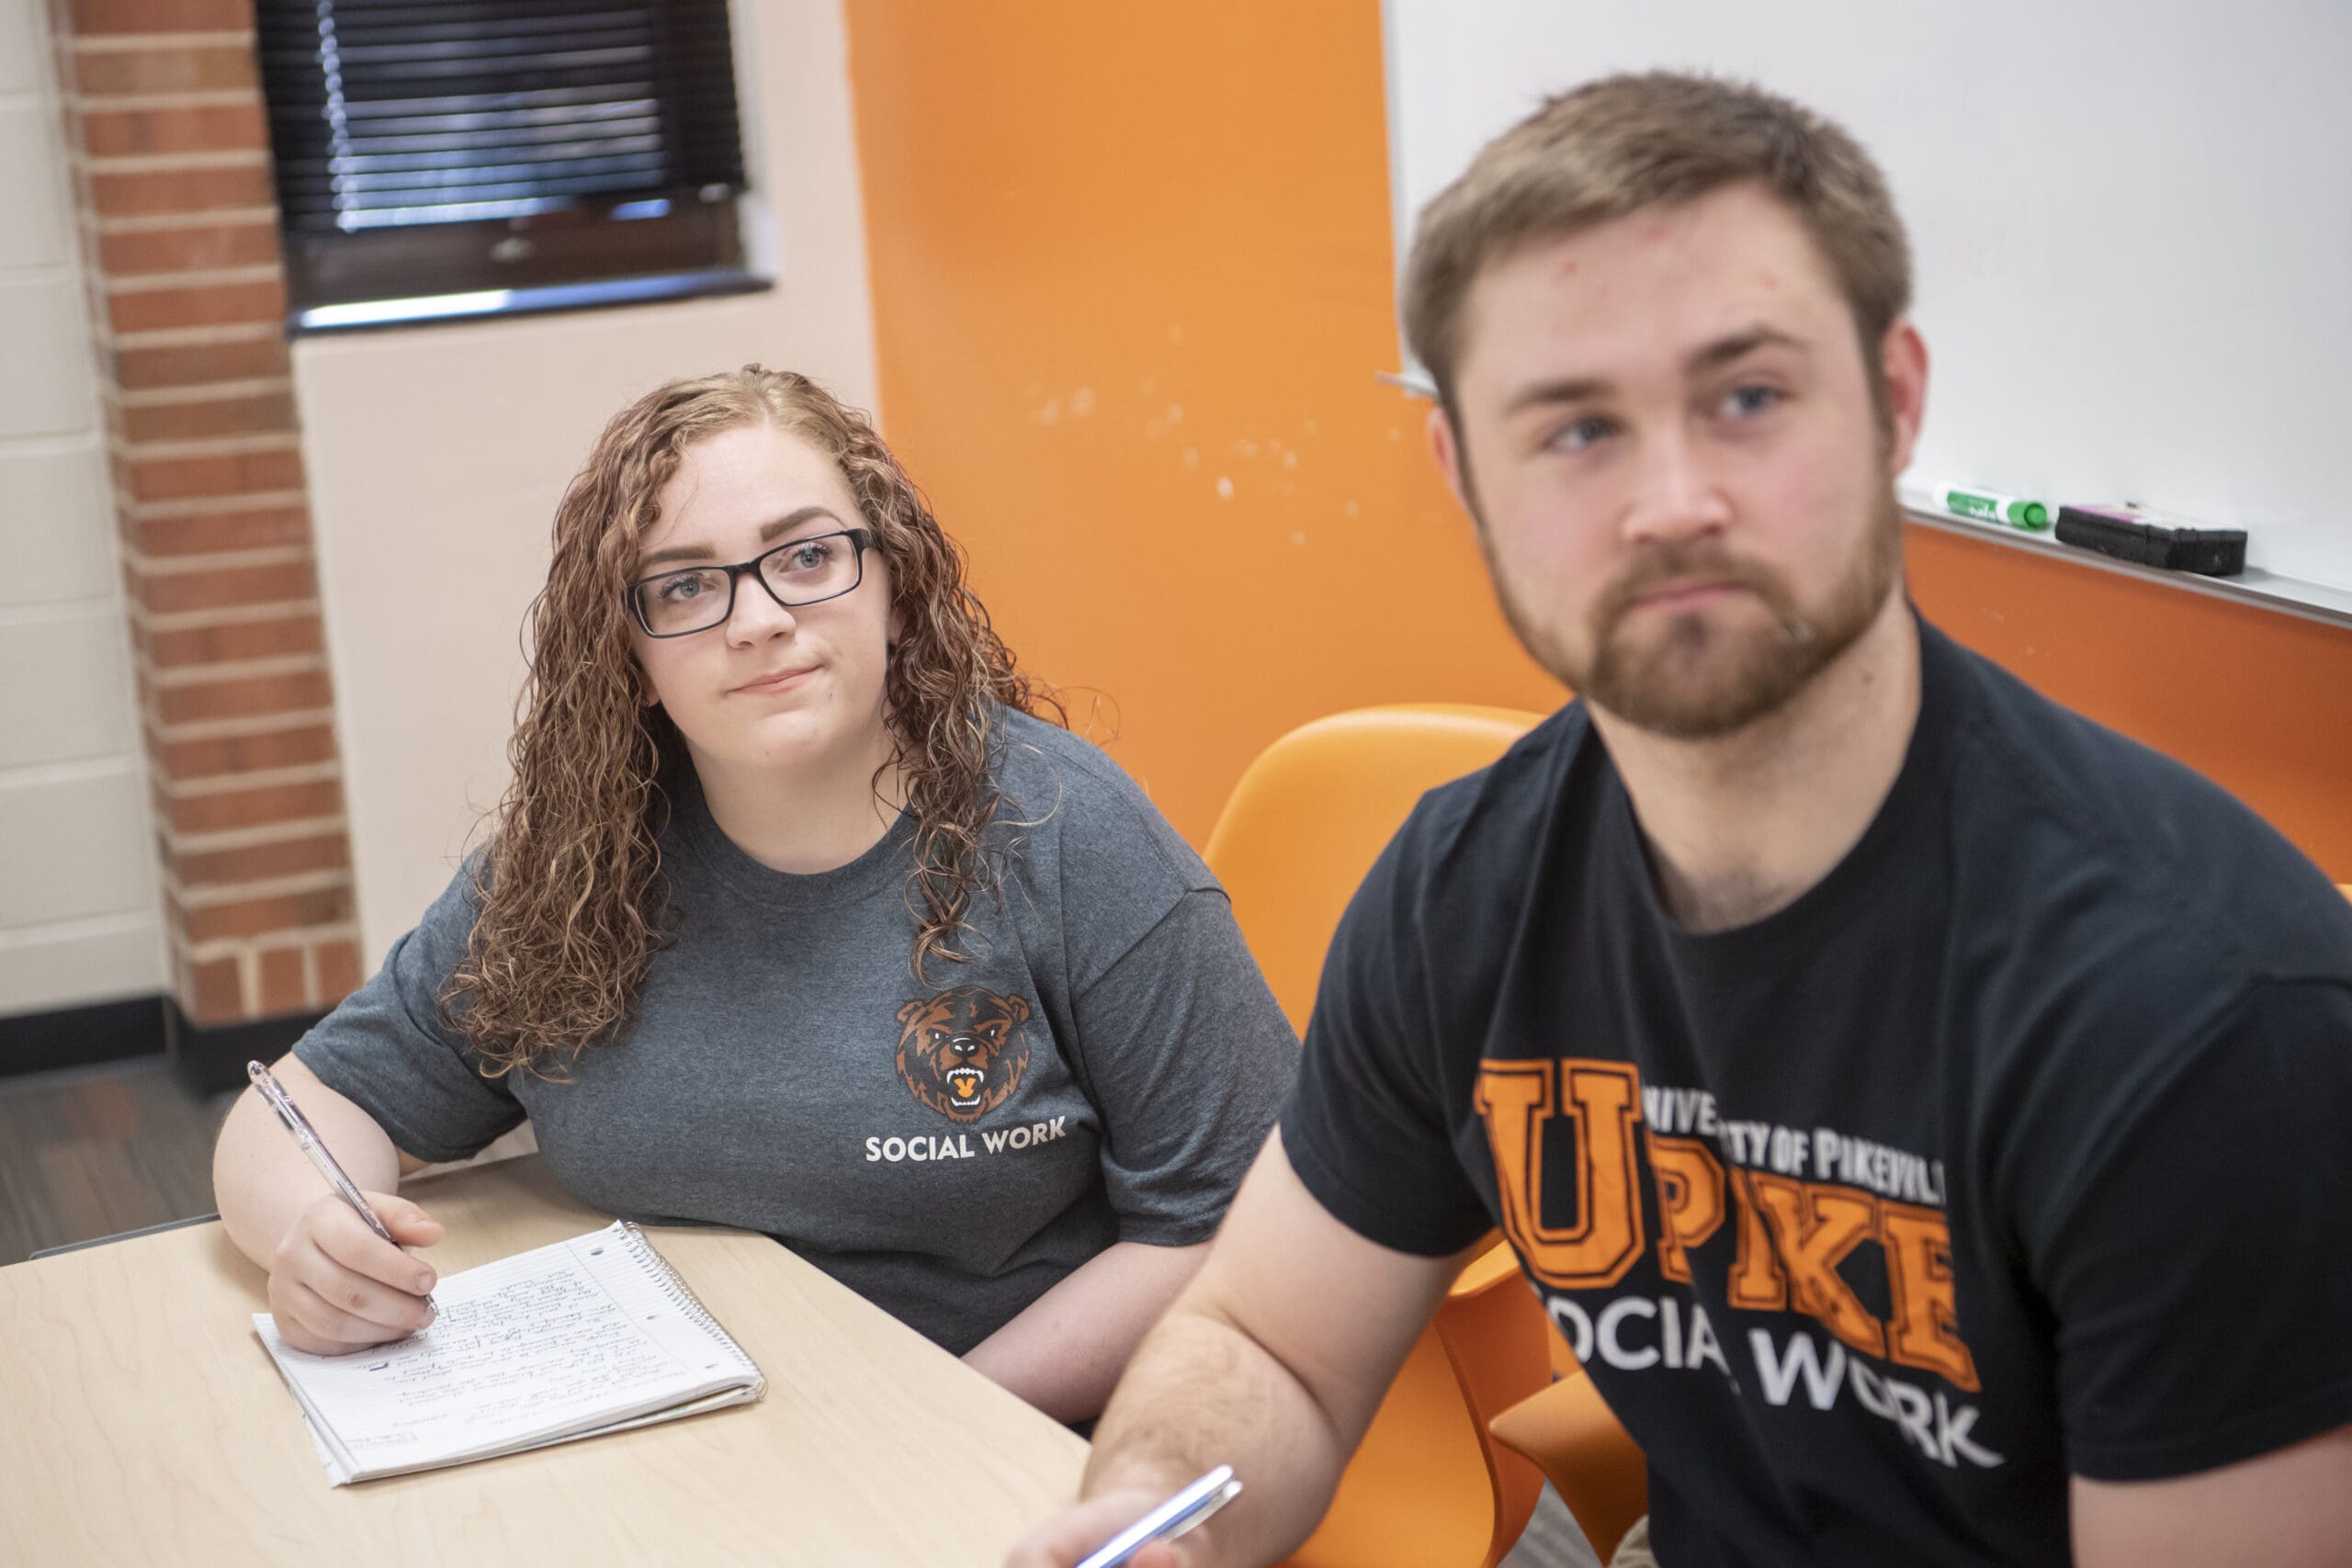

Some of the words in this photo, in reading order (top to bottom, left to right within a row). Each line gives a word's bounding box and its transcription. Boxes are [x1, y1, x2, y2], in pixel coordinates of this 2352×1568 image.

[865, 1134, 976, 1162] SOCIAL
[981, 1115, 1067, 1156] WORK
[1770, 1123, 1810, 1177] OF
[1545, 1295, 1742, 1396] OCIA
